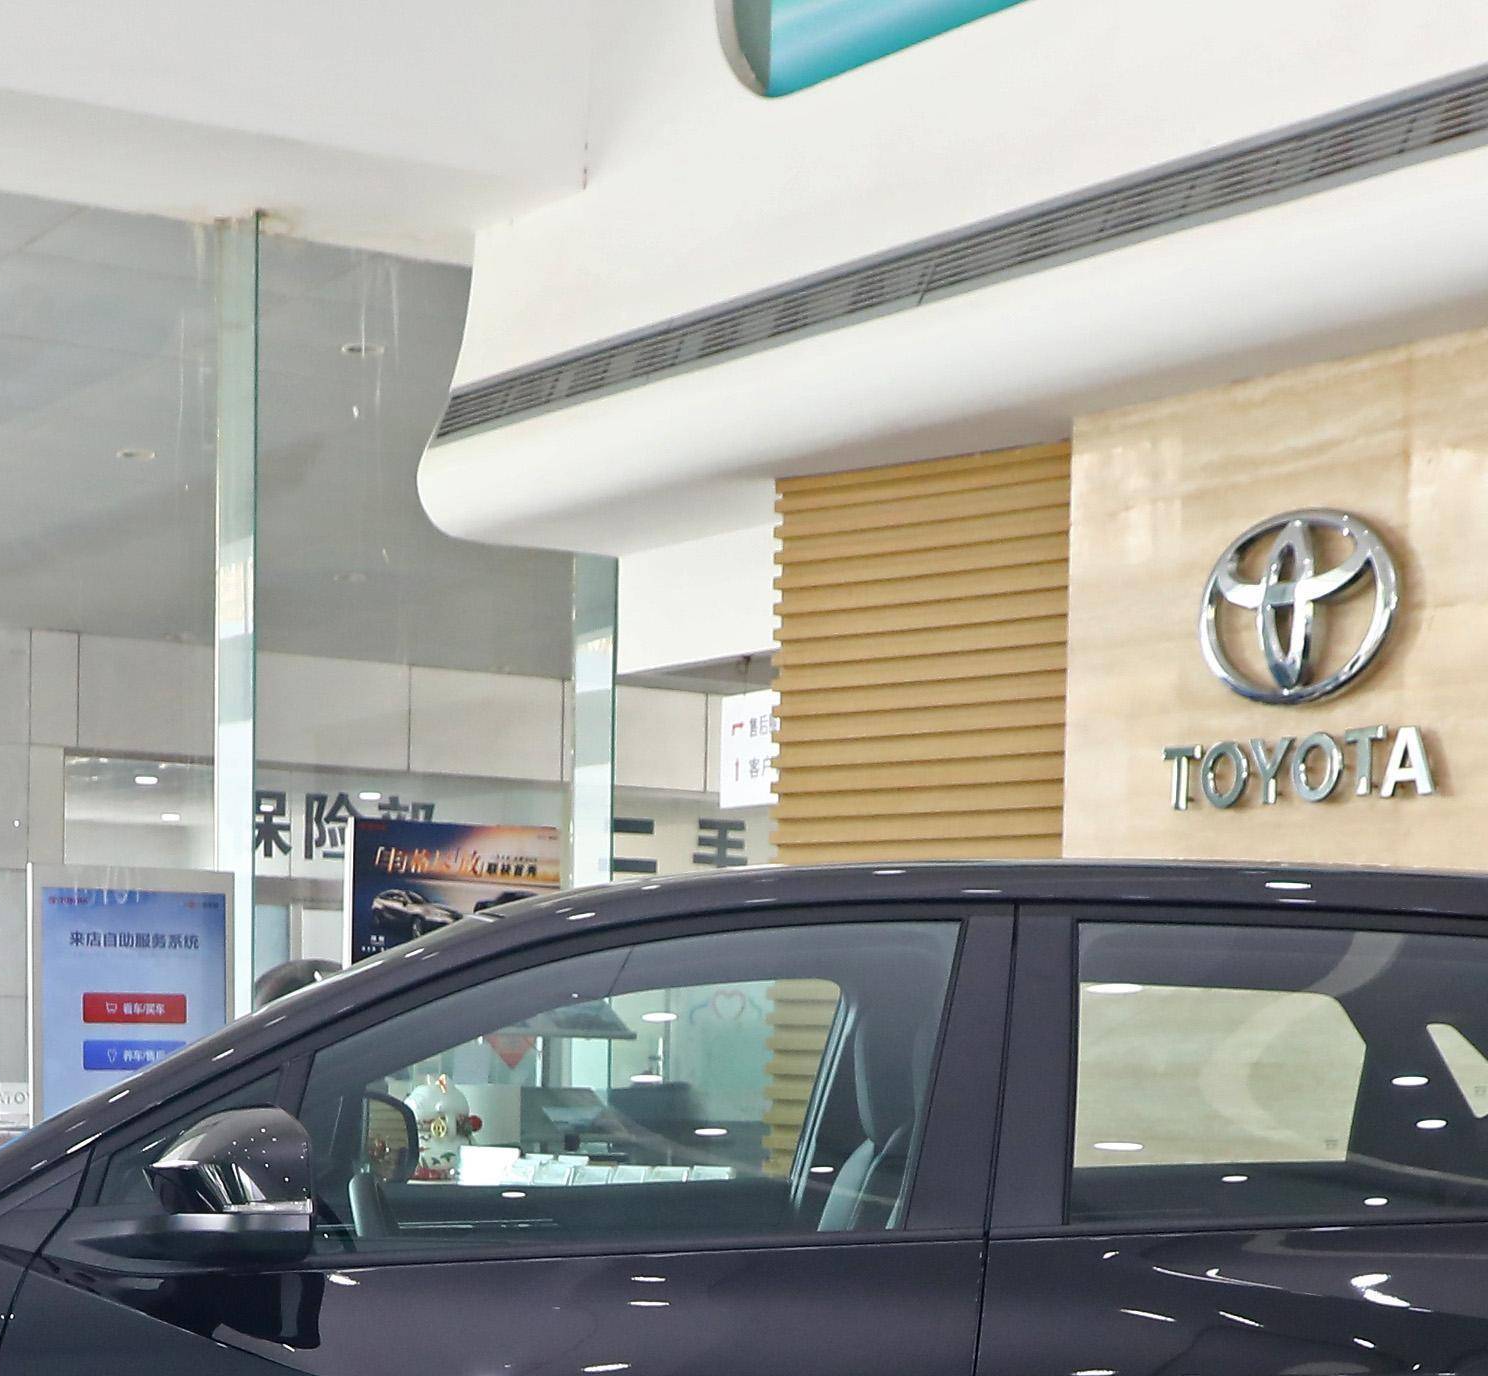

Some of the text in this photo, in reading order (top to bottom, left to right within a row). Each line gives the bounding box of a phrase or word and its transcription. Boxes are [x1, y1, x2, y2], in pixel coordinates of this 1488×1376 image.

[1161, 725, 1436, 811] TOYOTA
[69, 930, 200, 950] 来店自助服务系统
